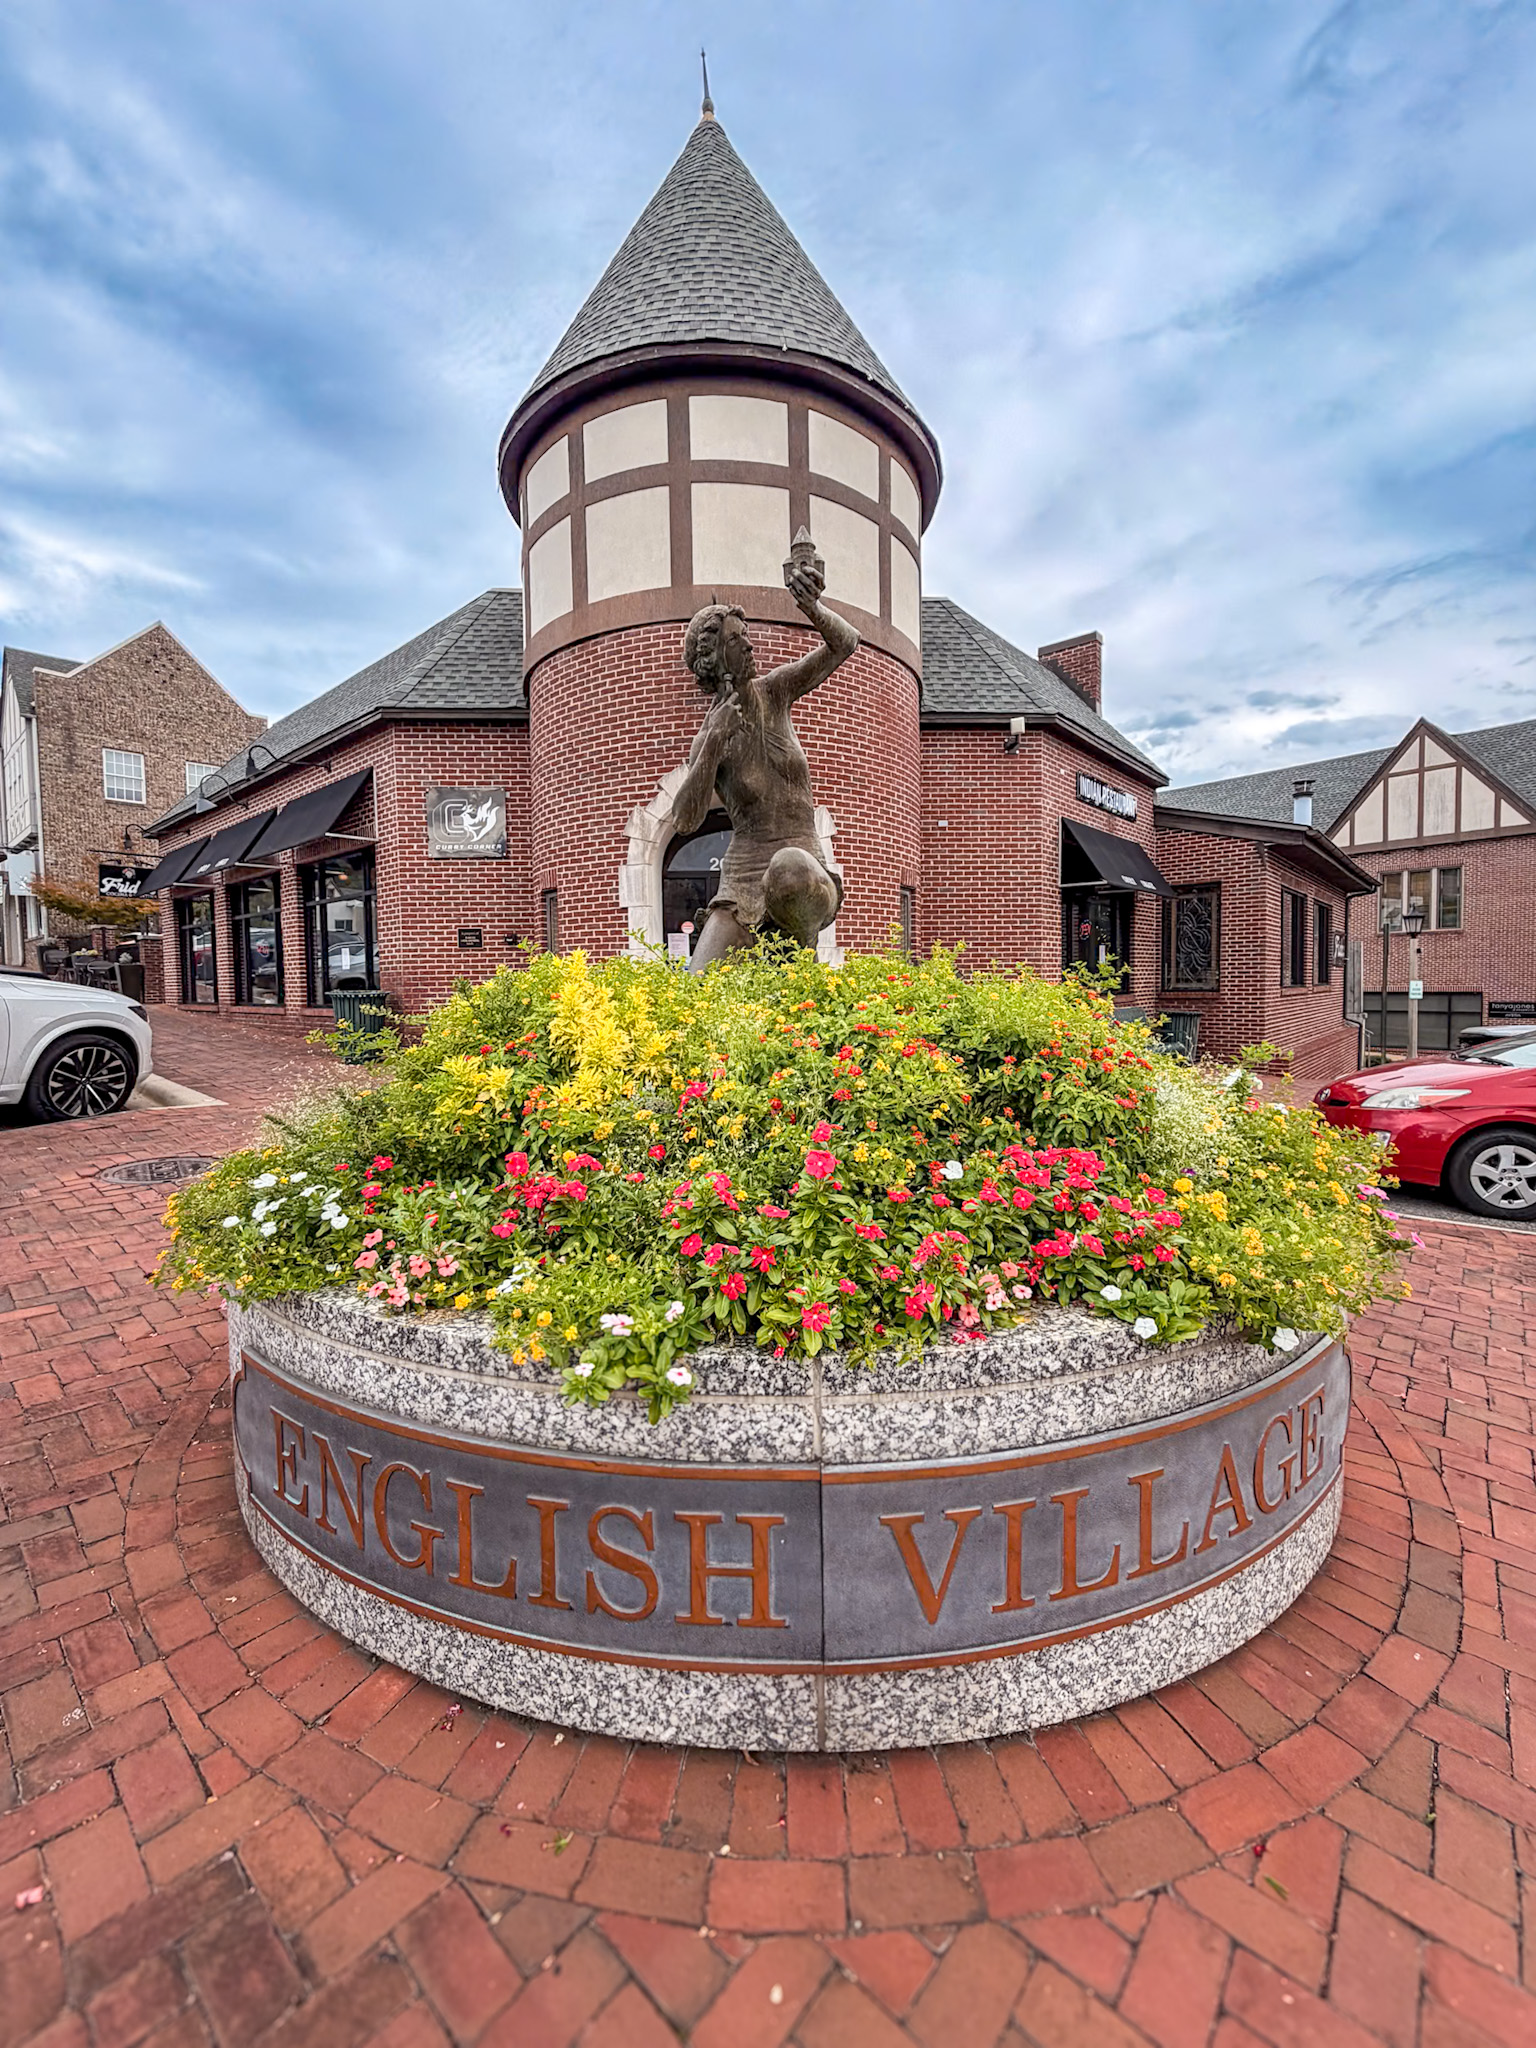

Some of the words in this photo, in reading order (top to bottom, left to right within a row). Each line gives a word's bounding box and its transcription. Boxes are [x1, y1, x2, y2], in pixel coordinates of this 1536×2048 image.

[1080, 775, 1102, 804] INDIAN
[100, 877, 142, 893] Frid
[270, 1405, 788, 1628] ENGLISH
[879, 1385, 1325, 1625] VILLAGE
